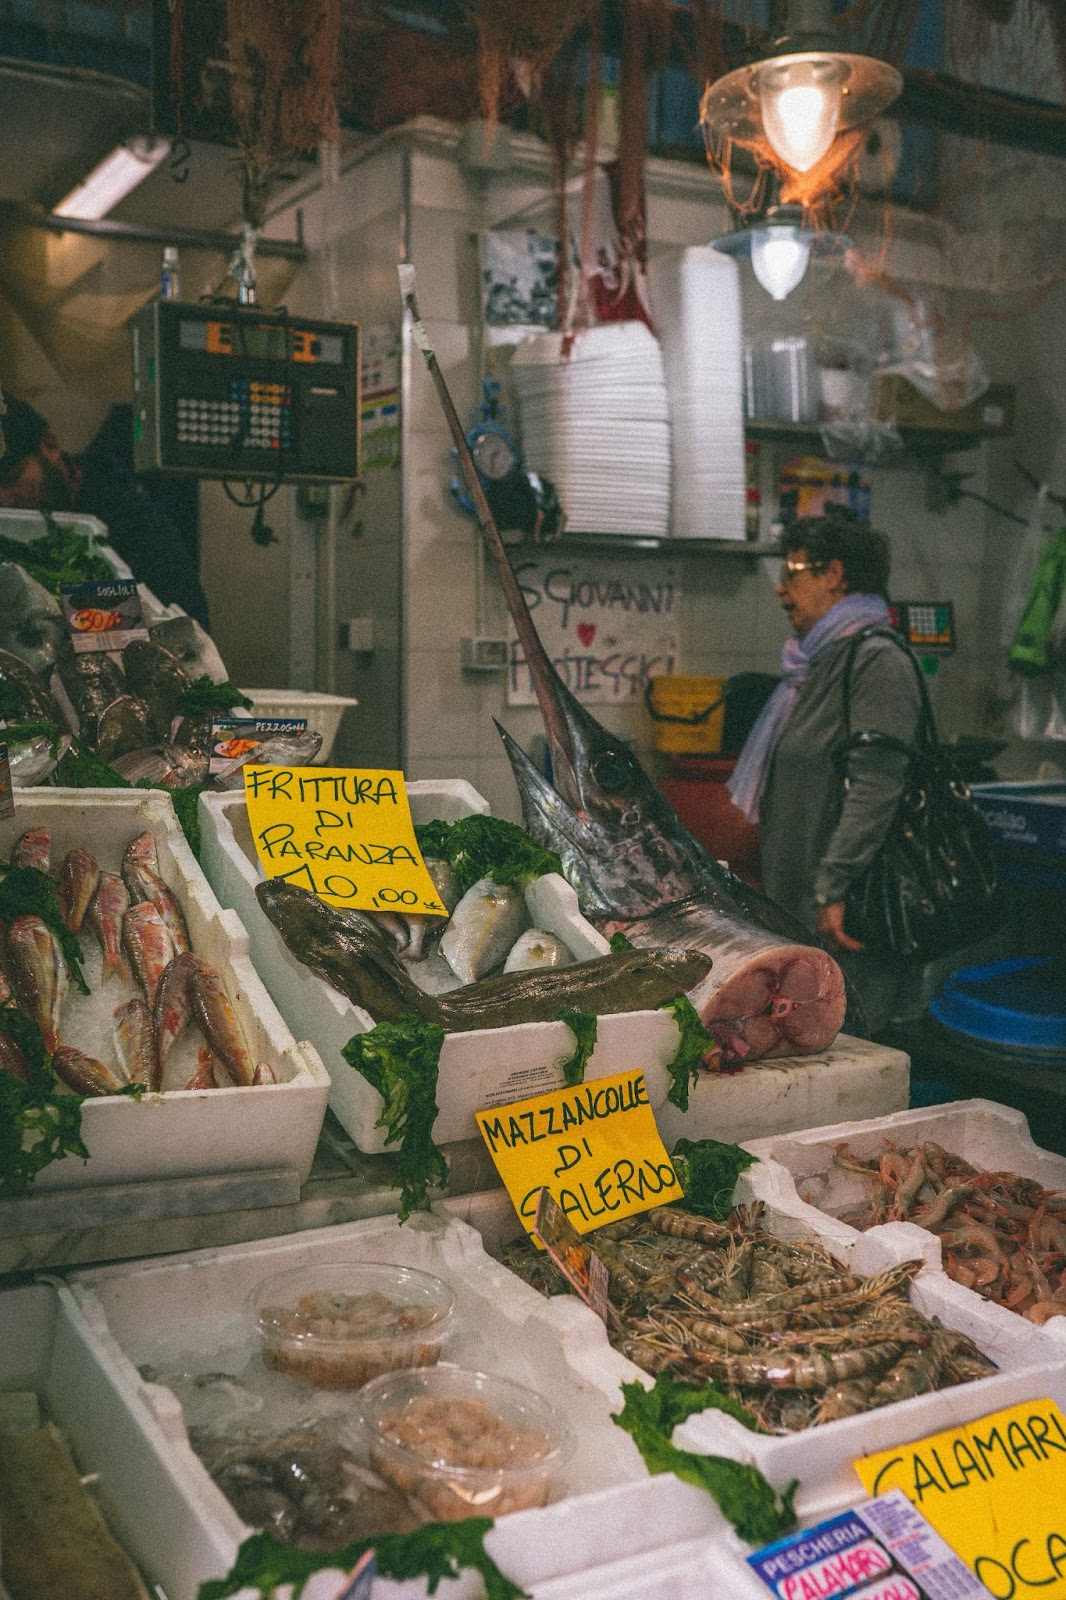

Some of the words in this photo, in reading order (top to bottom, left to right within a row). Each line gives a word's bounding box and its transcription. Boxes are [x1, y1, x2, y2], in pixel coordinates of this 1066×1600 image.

[246, 769, 398, 805] FRITTURA
[258, 823, 419, 866] PARANZA
[315, 810, 354, 837] DI
[481, 1075, 650, 1153] MAZZANCOLLE
[554, 1137, 593, 1178] DI
[761, 1523, 869, 1579] PESCHERIA
